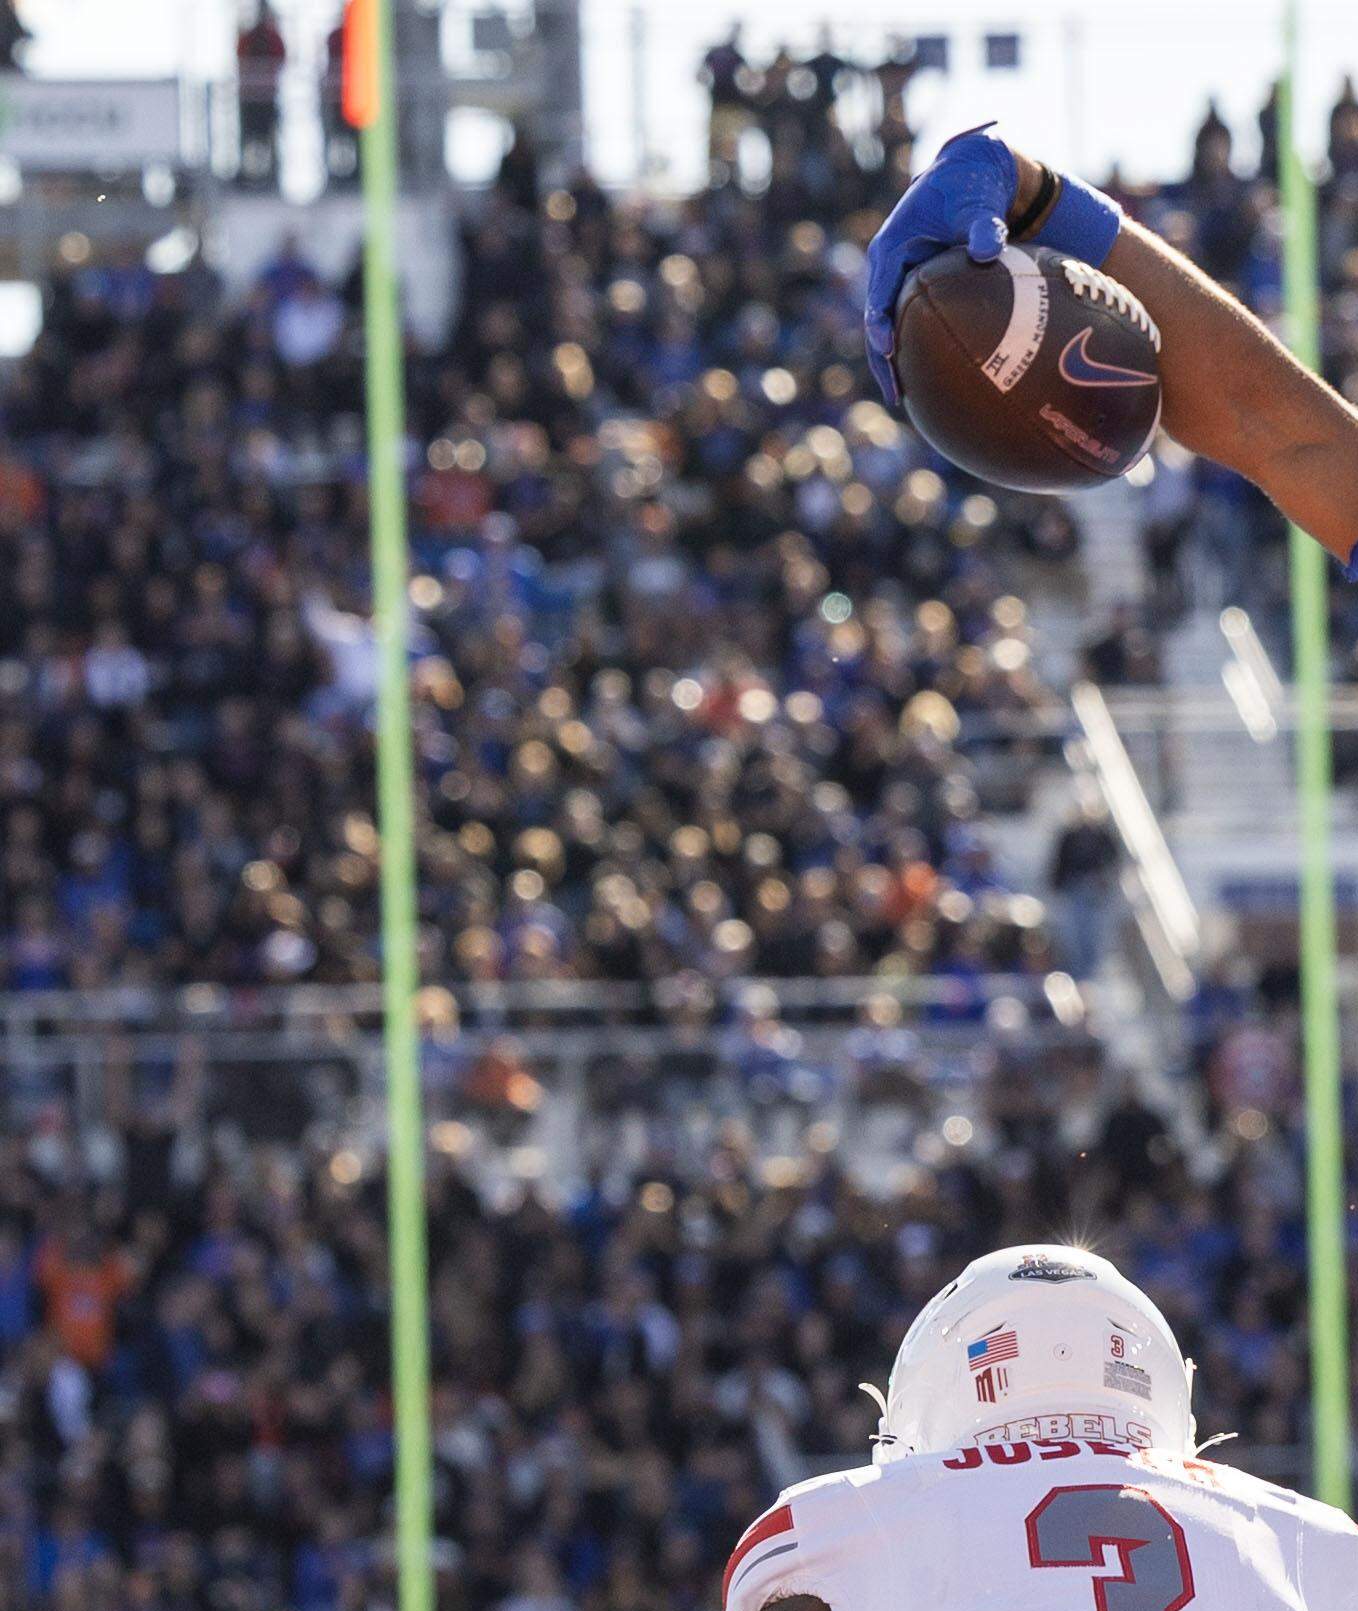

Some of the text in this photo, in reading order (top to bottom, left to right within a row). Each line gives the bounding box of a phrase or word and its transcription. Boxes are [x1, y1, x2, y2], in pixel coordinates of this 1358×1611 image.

[1020, 1268, 1084, 1278] LAS VEGAS
[1111, 1335, 1125, 1358] 3
[973, 1413, 1153, 1448] REBELS
